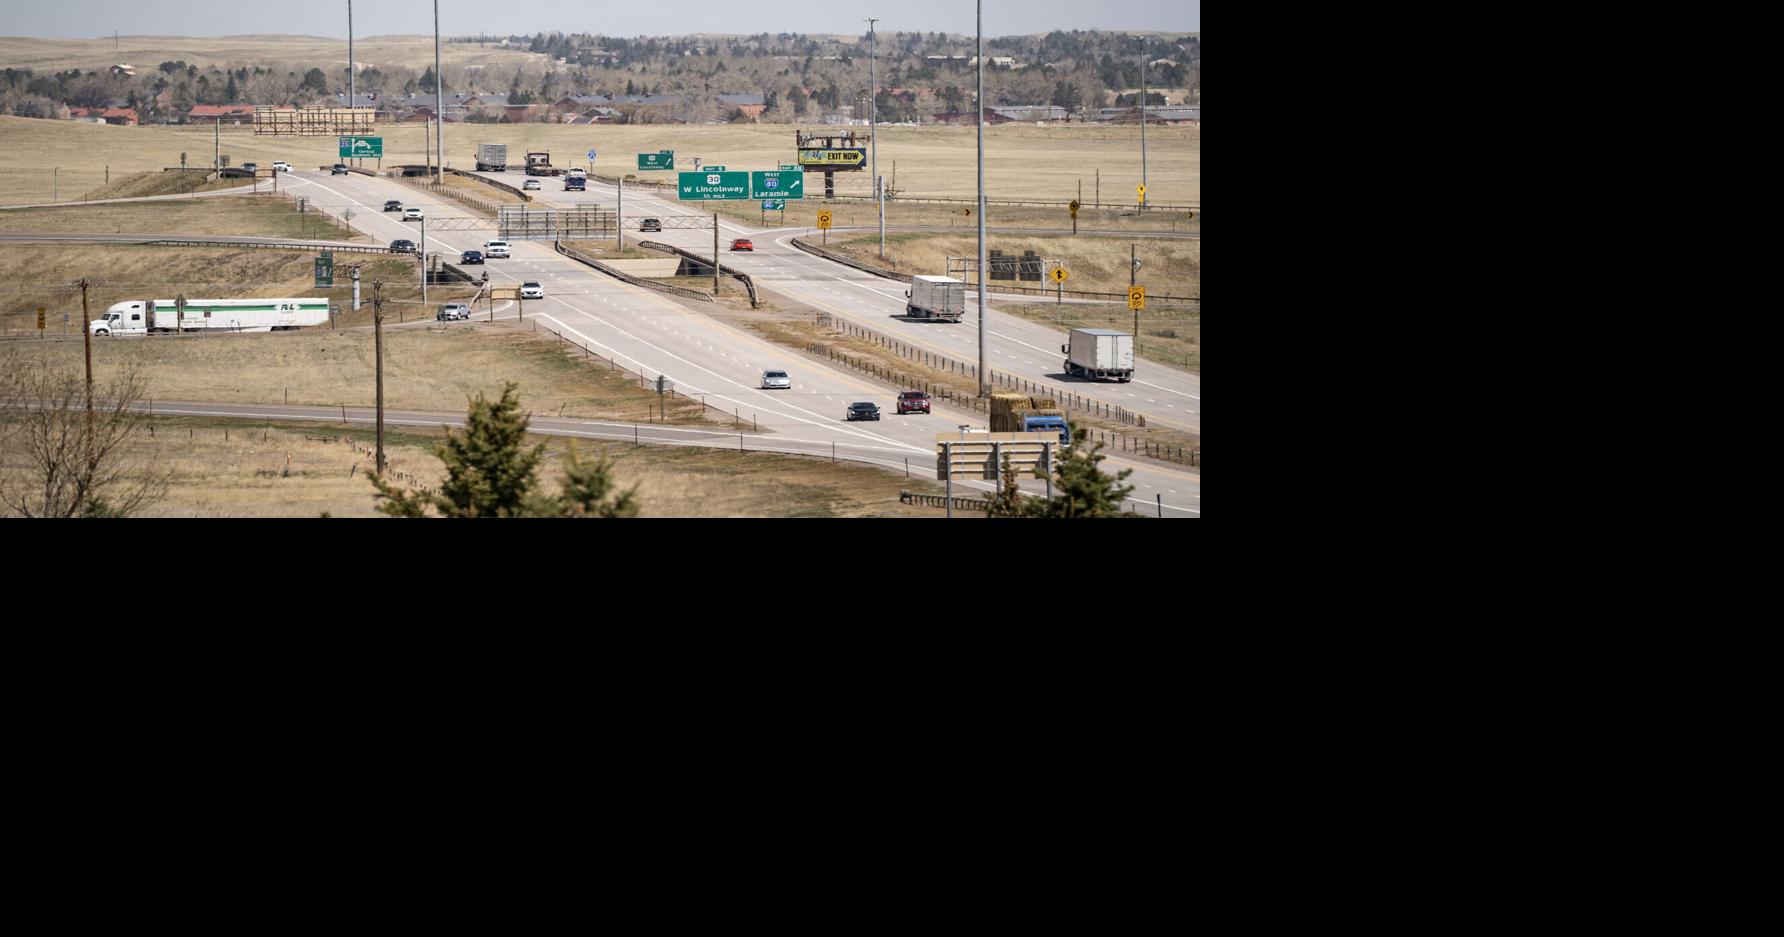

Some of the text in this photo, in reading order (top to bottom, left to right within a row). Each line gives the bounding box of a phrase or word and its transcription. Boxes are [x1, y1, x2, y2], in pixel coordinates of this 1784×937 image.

[827, 152, 842, 160] EXIT
[843, 152, 859, 160] NOW
[696, 185, 744, 193] Lincolnway
